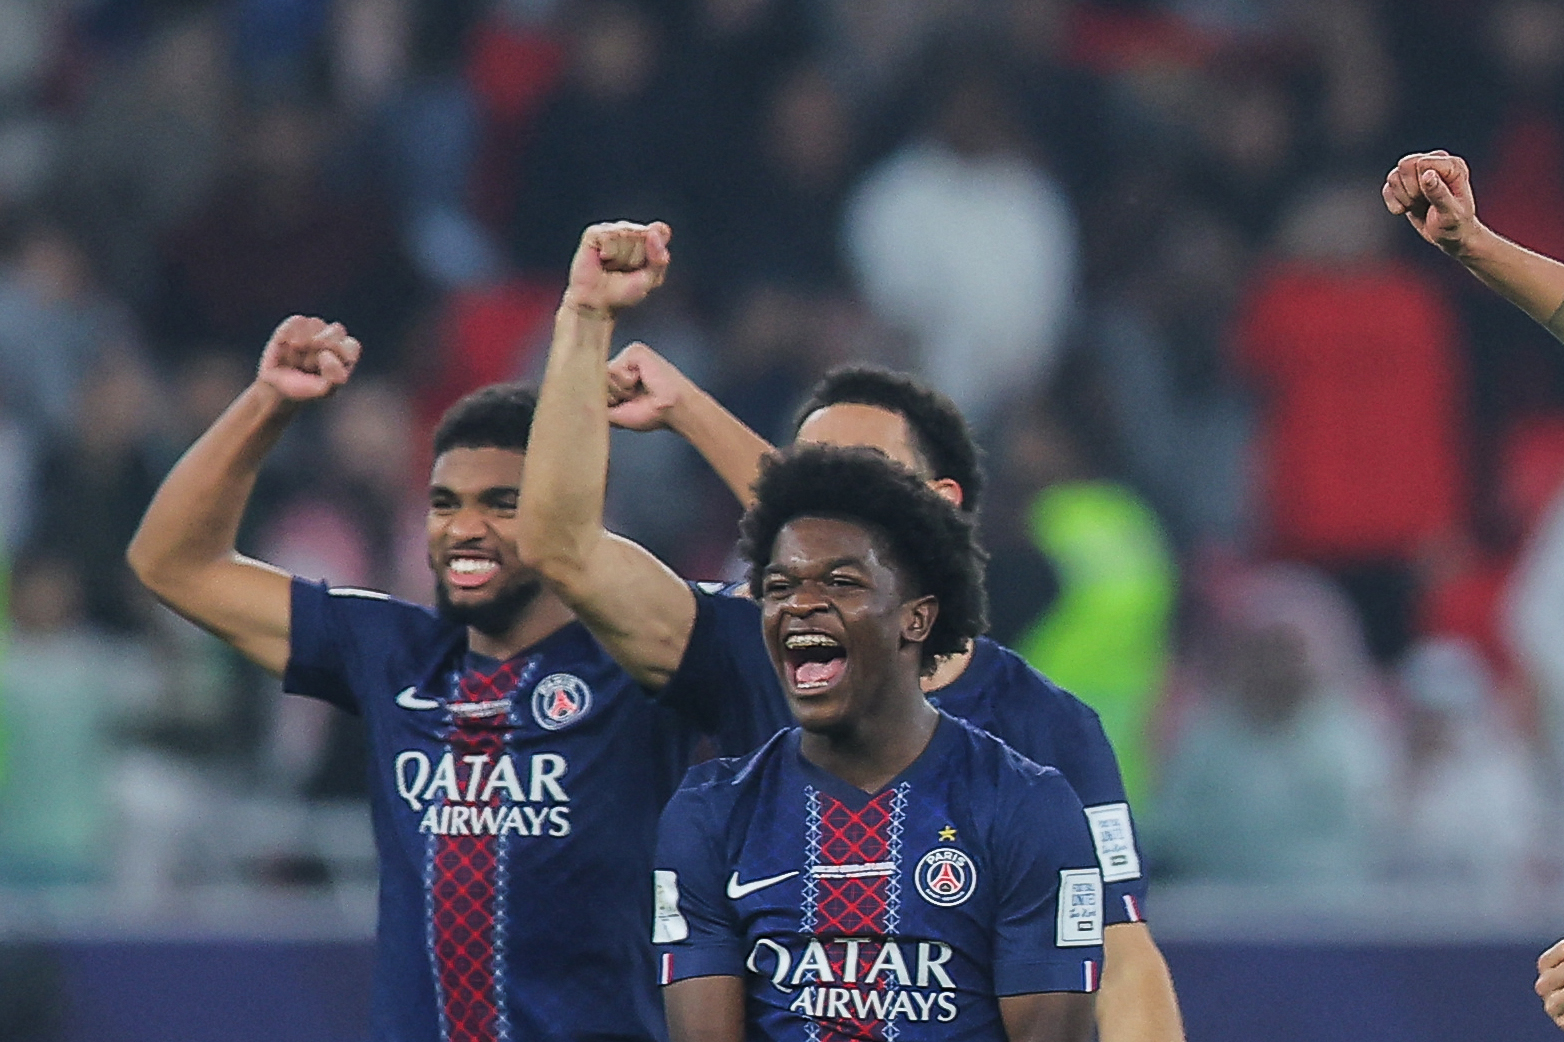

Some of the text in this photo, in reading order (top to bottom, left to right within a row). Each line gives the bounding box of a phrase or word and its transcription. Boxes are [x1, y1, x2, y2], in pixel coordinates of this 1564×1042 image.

[395, 751, 570, 812] QATAR
[419, 805, 571, 837] AIRWAYS
[926, 850, 966, 867] PARIS
[746, 937, 957, 993] QATAR
[790, 986, 957, 1022] AIRWAYS
